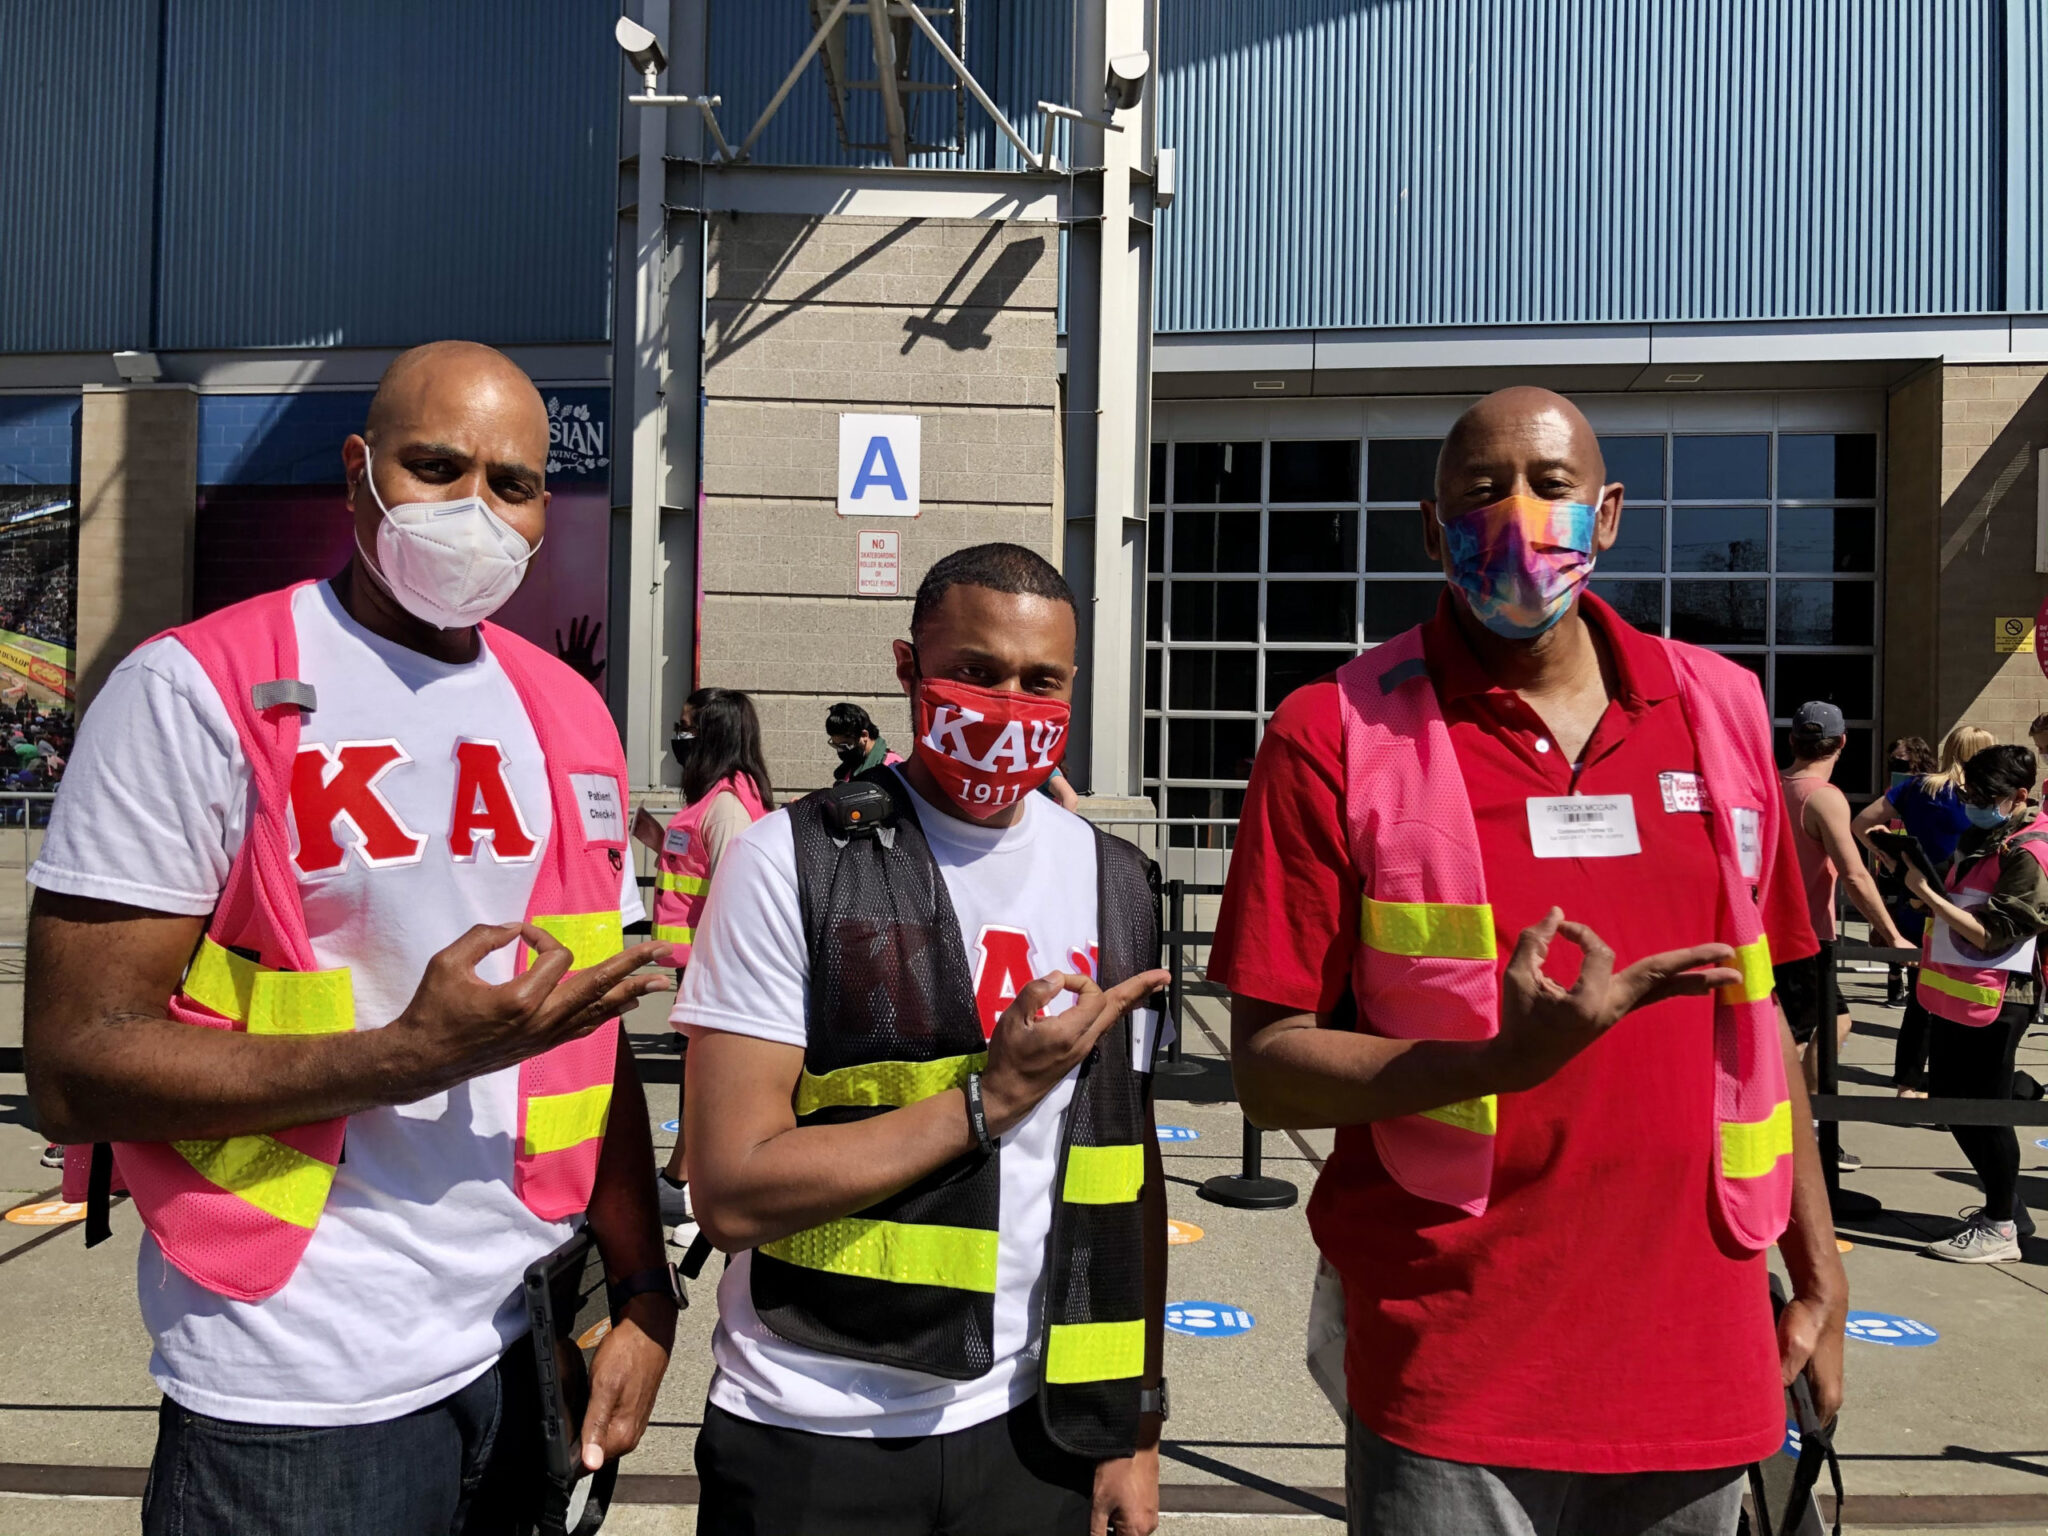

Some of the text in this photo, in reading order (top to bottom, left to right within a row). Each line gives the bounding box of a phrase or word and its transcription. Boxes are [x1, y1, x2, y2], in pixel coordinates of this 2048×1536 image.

[549, 422, 604, 456] SIAN
[549, 450, 578, 460] WING
[850, 436, 908, 501] A
[872, 539, 885, 549] NO
[2, 651, 29, 667] DUNLOP
[588, 791, 611, 801] Patient
[958, 779, 1020, 806] 1911
[1547, 805, 1581, 813] PATRICK
[975, 1113, 985, 1132] Dream
